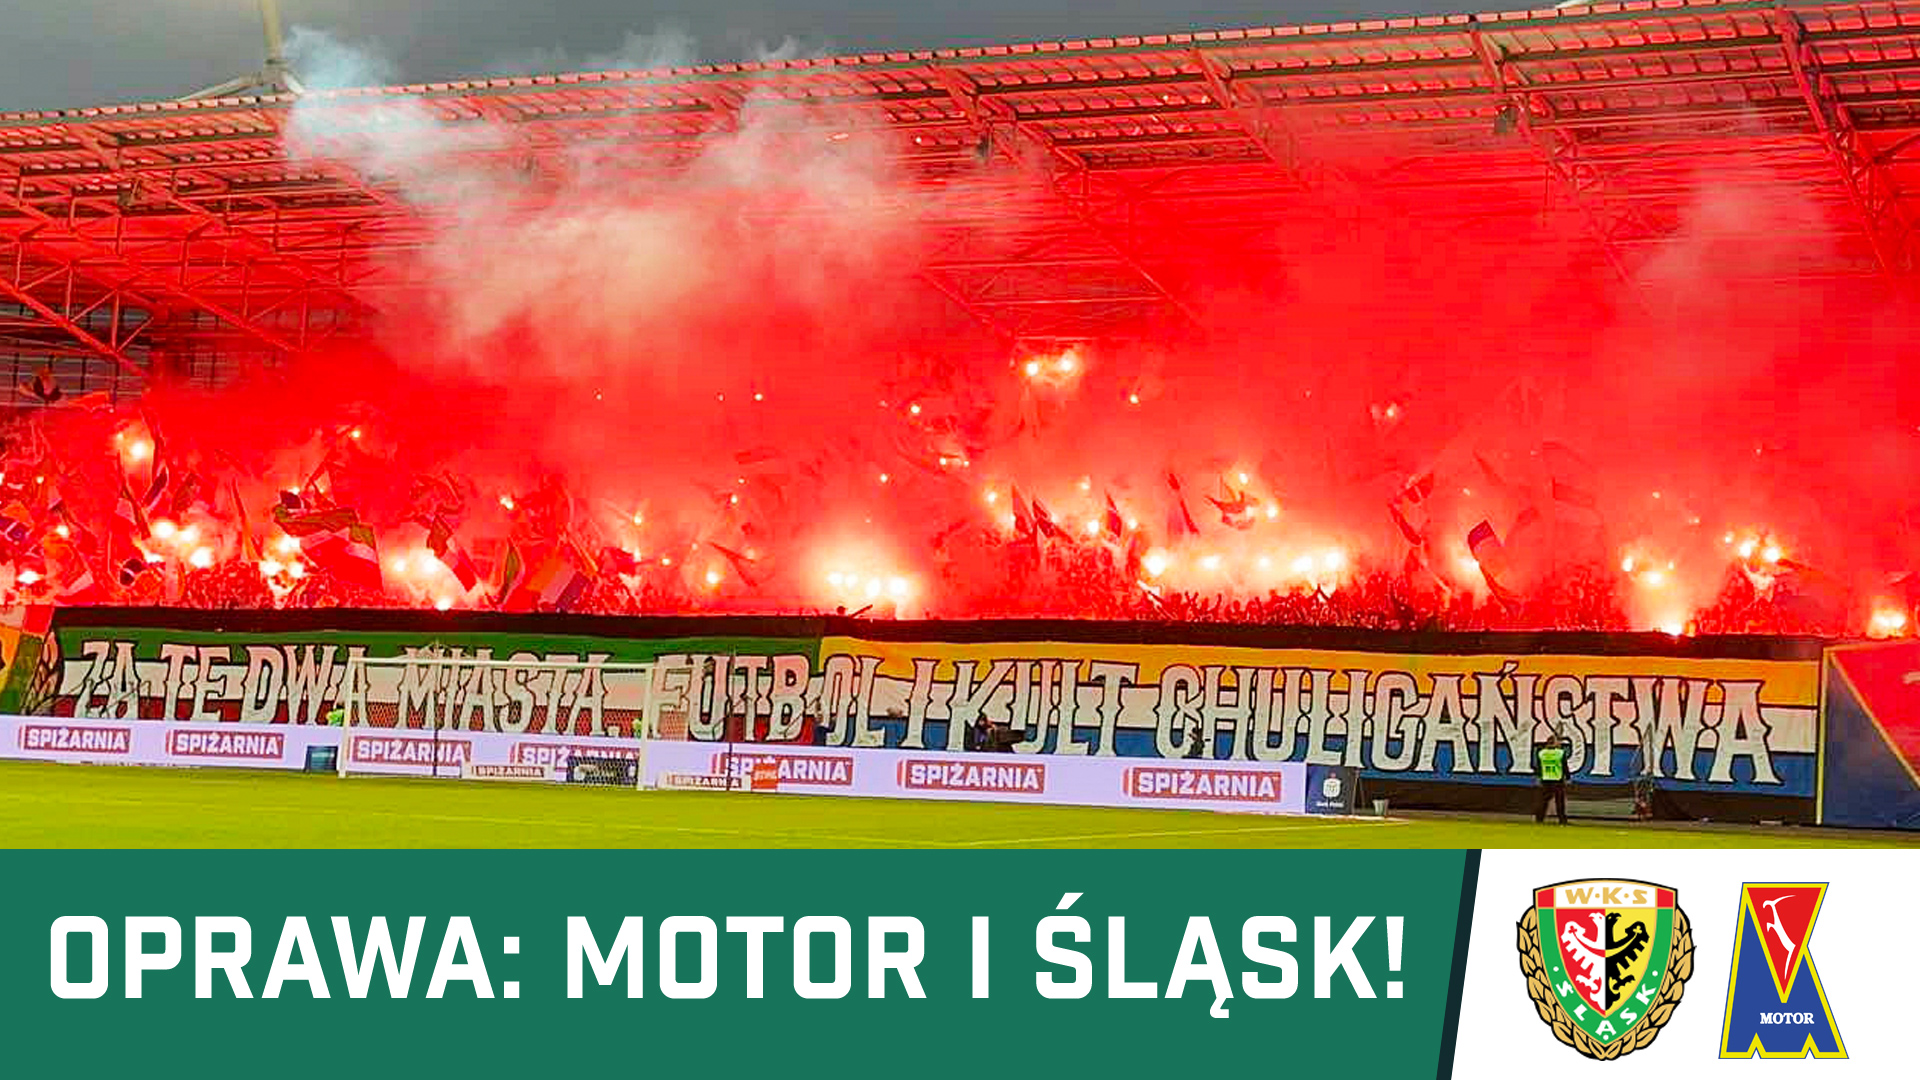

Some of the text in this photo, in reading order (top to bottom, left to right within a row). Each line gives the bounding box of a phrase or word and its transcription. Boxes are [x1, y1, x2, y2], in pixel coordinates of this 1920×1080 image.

[73, 640, 140, 719] ZA
[159, 642, 233, 722] TE
[240, 644, 370, 728] DWA
[648, 653, 886, 747] FUTBOL
[900, 658, 940, 749] I
[946, 658, 1139, 759] KULT
[1153, 661, 1783, 785] CHULIGAŃSTWA
[28, 727, 127, 751] SPIŻARNIA
[175, 731, 280, 756] SPIŻARNIA
[909, 763, 1041, 790] SPIŻARNIA
[1138, 770, 1275, 797] SPIŻARNIA
